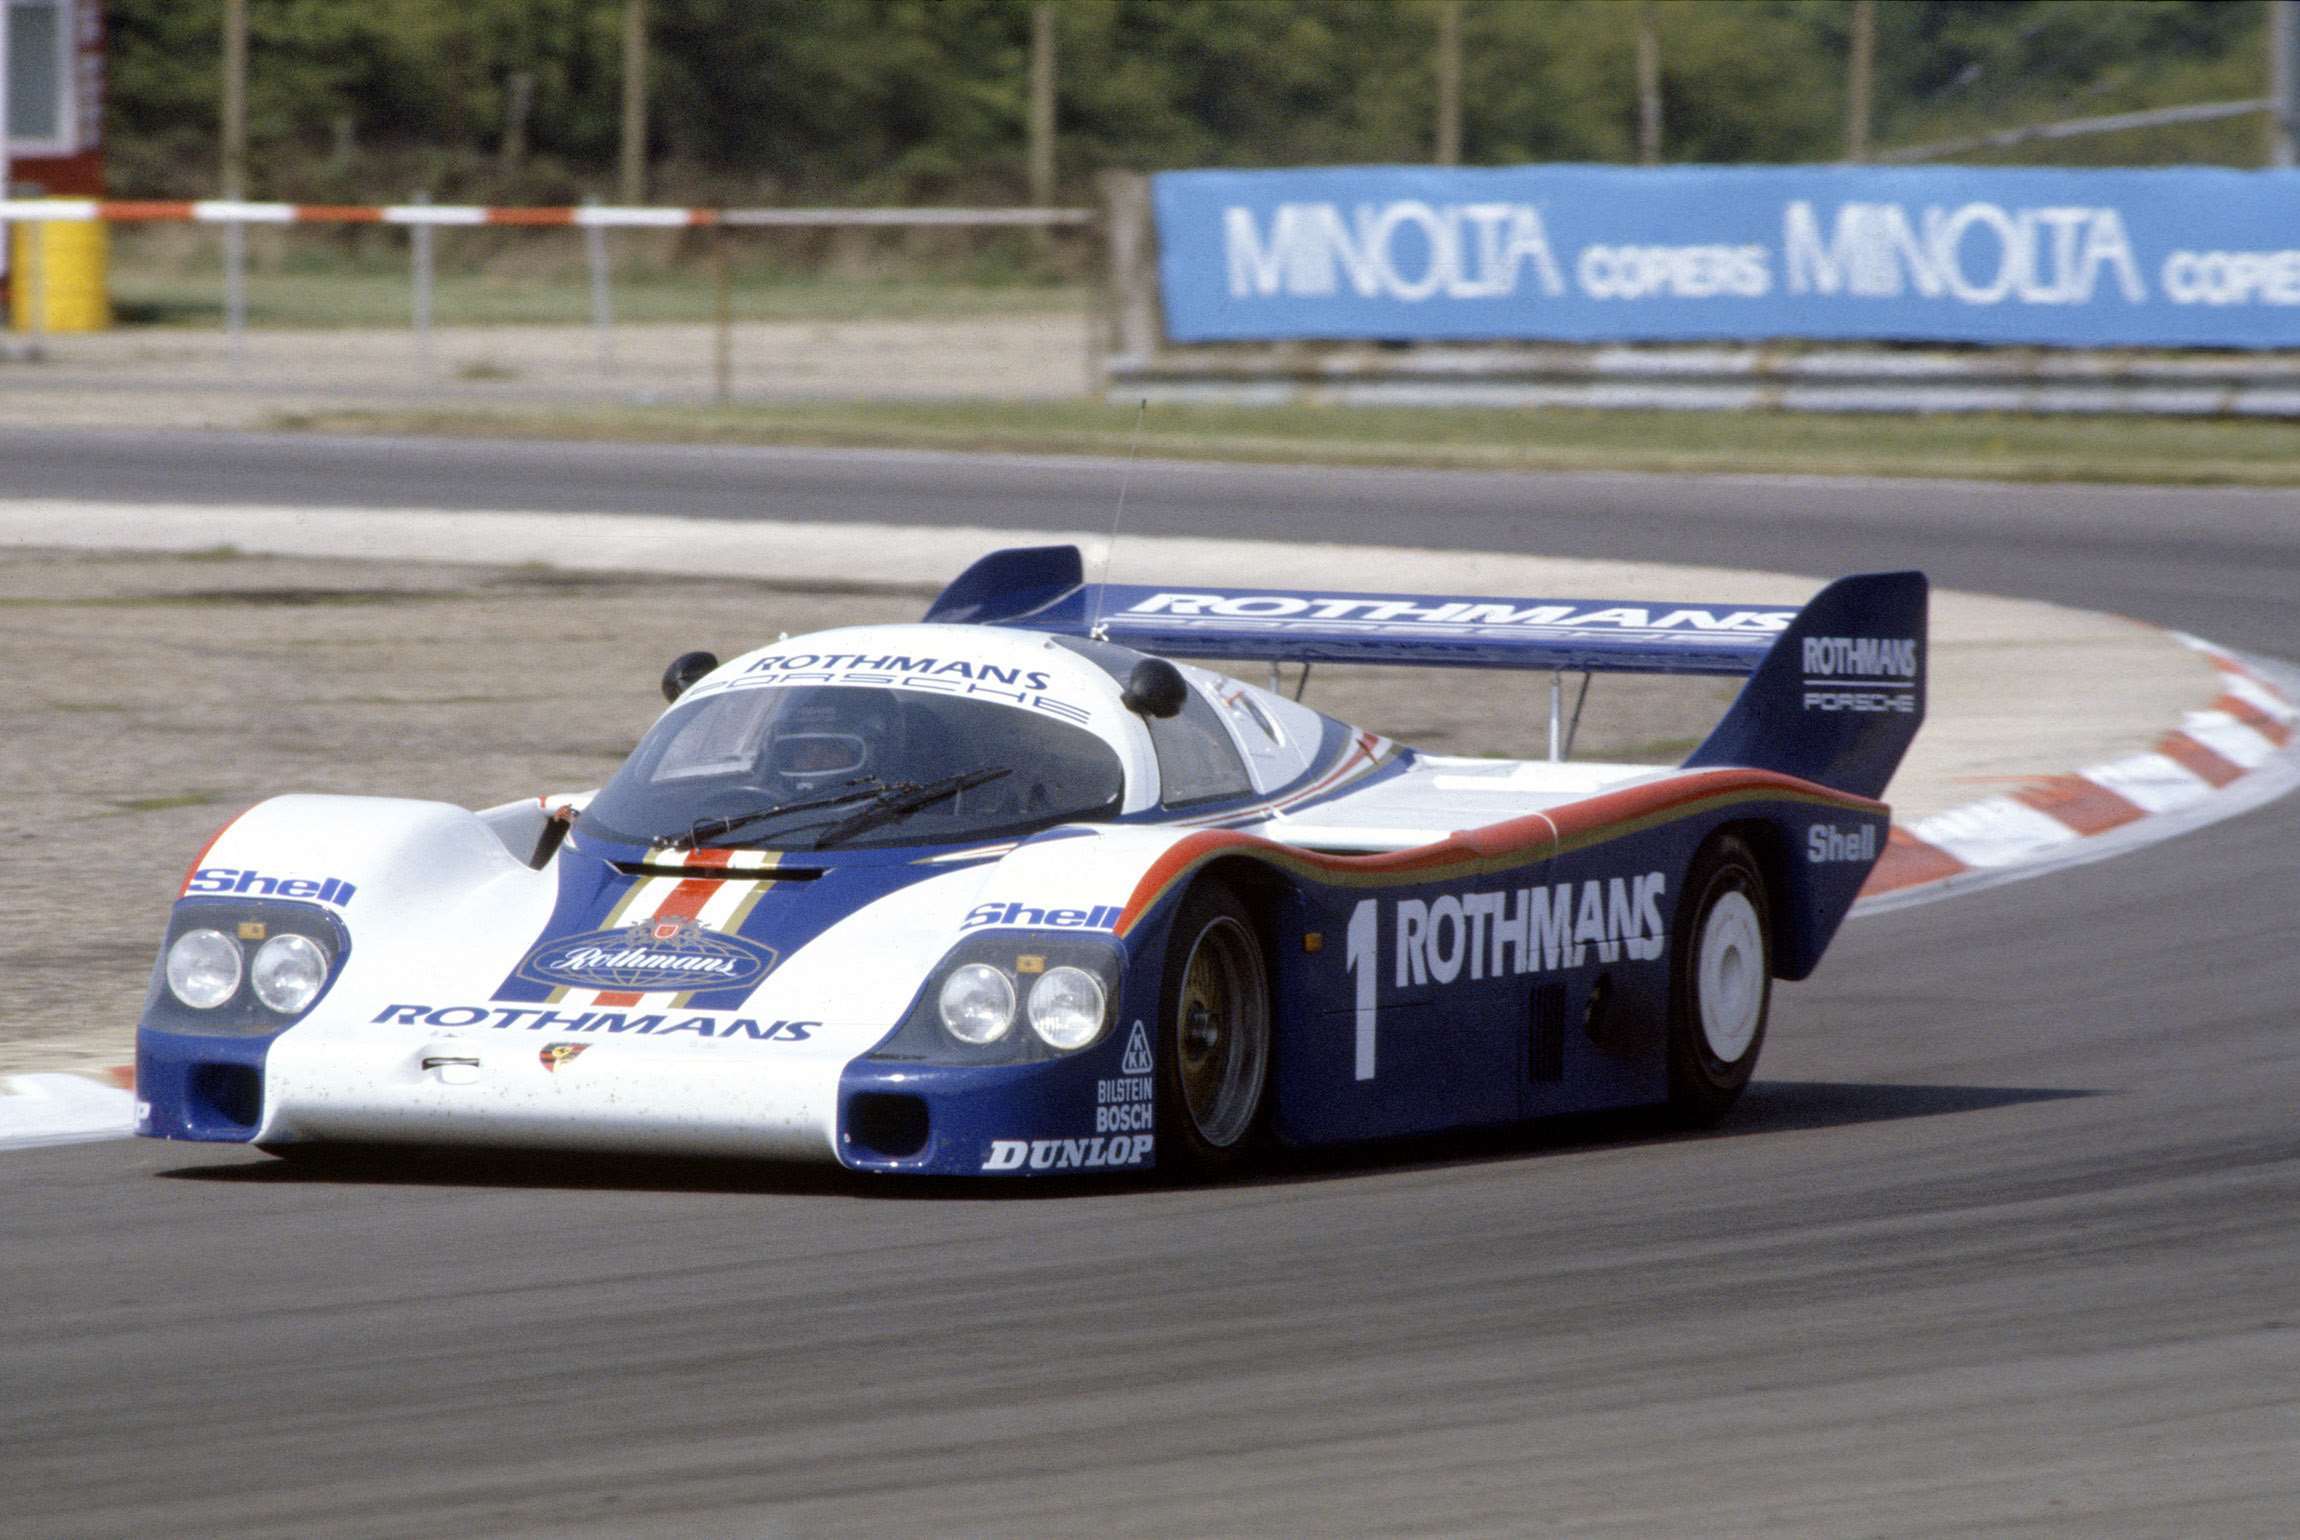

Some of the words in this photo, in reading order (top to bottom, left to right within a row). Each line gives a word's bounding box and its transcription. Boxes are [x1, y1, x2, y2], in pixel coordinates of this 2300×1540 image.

[1223, 200, 1566, 302] MINOLTA
[1577, 243, 1772, 301] COPIERS
[1783, 200, 2147, 306] MINOLTA
[1128, 592, 1798, 631] ROTHMANS
[745, 653, 1051, 690] ROTHMANS
[1802, 637, 1916, 677] ROTHMANS
[688, 672, 1091, 725] PORSCHE
[1803, 693, 1914, 712] PORSCHE
[1809, 824, 1876, 863] Shell
[188, 868, 357, 907] Shell
[962, 902, 1125, 930] Shell
[1396, 871, 1666, 988] ROTHMANS
[550, 946, 738, 977] Rothmans
[1346, 899, 1378, 1082] 1
[371, 1004, 823, 1042] ROTHMANS
[1098, 1077, 1153, 1104] BILSTEIN
[1096, 1103, 1153, 1133] BOSCH
[981, 1134, 1154, 1171] DUNLOP
